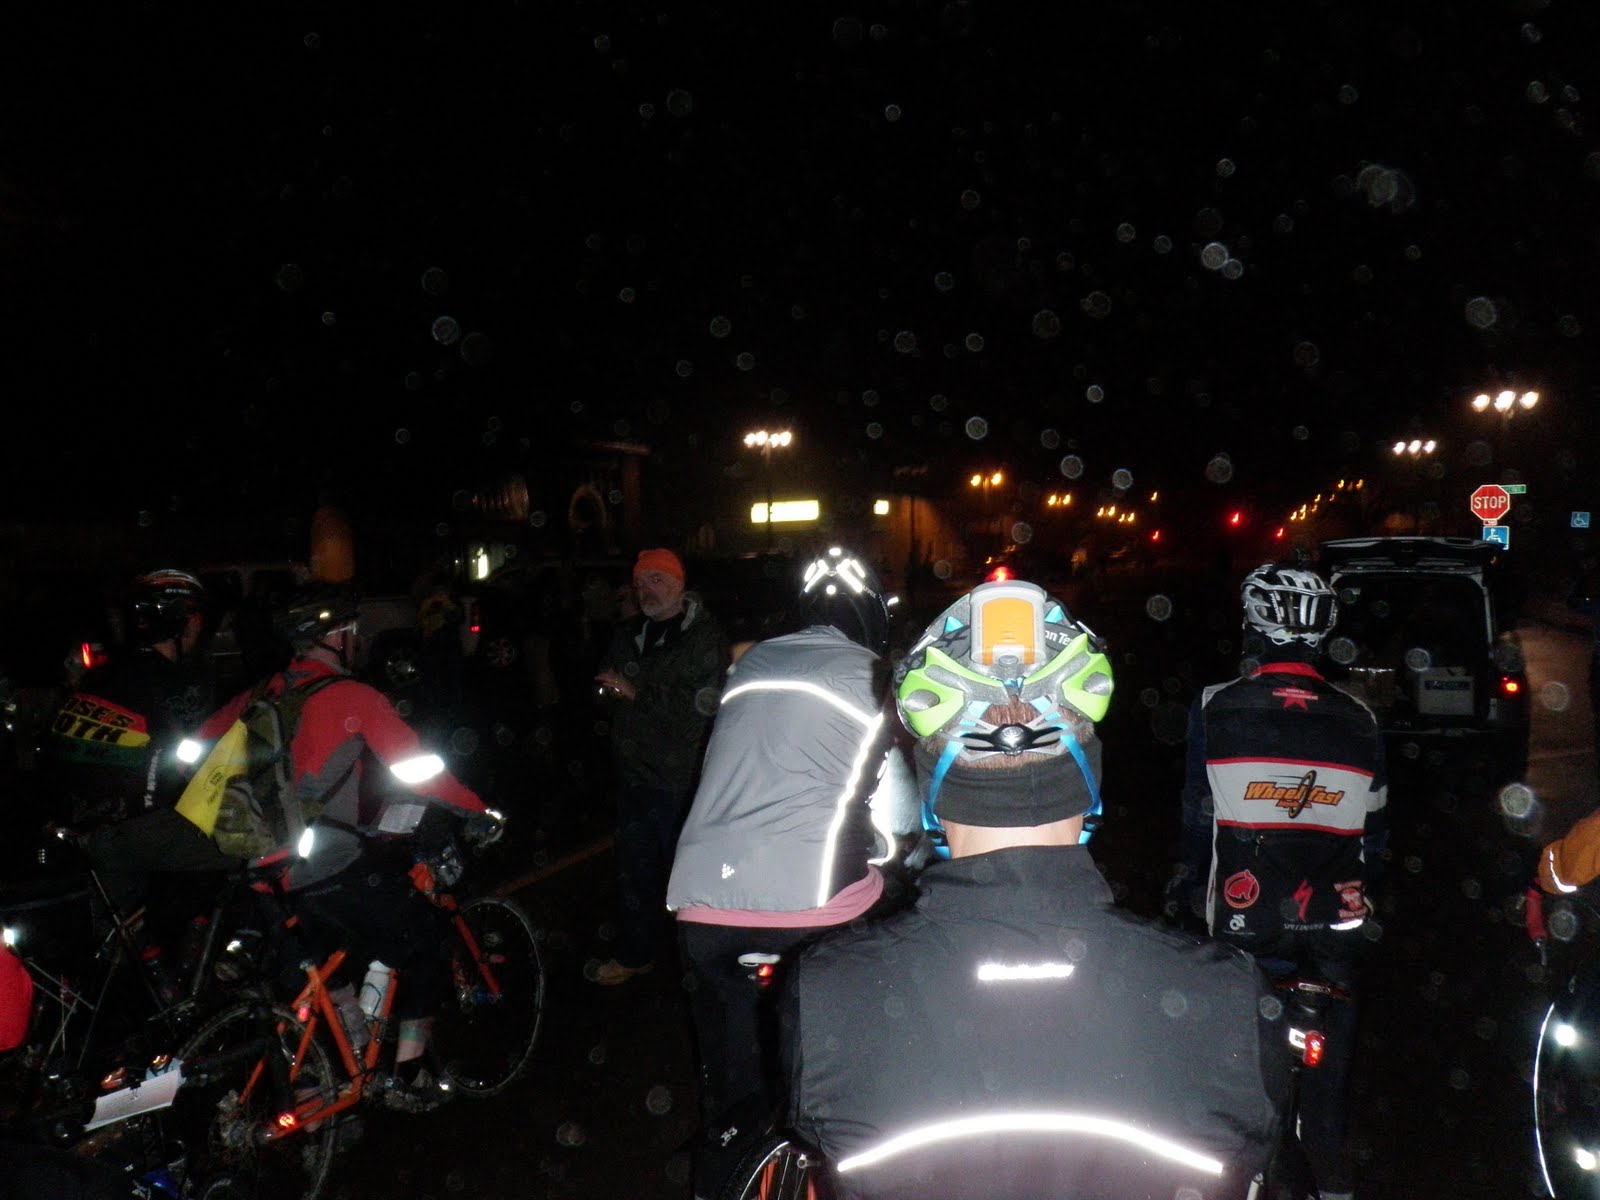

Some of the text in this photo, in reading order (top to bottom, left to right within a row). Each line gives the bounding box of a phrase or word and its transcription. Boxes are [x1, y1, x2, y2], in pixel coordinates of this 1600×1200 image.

[1473, 495, 1506, 510] STOP
[1059, 632, 1073, 645] Te
[1244, 781, 1308, 801] Wheel
